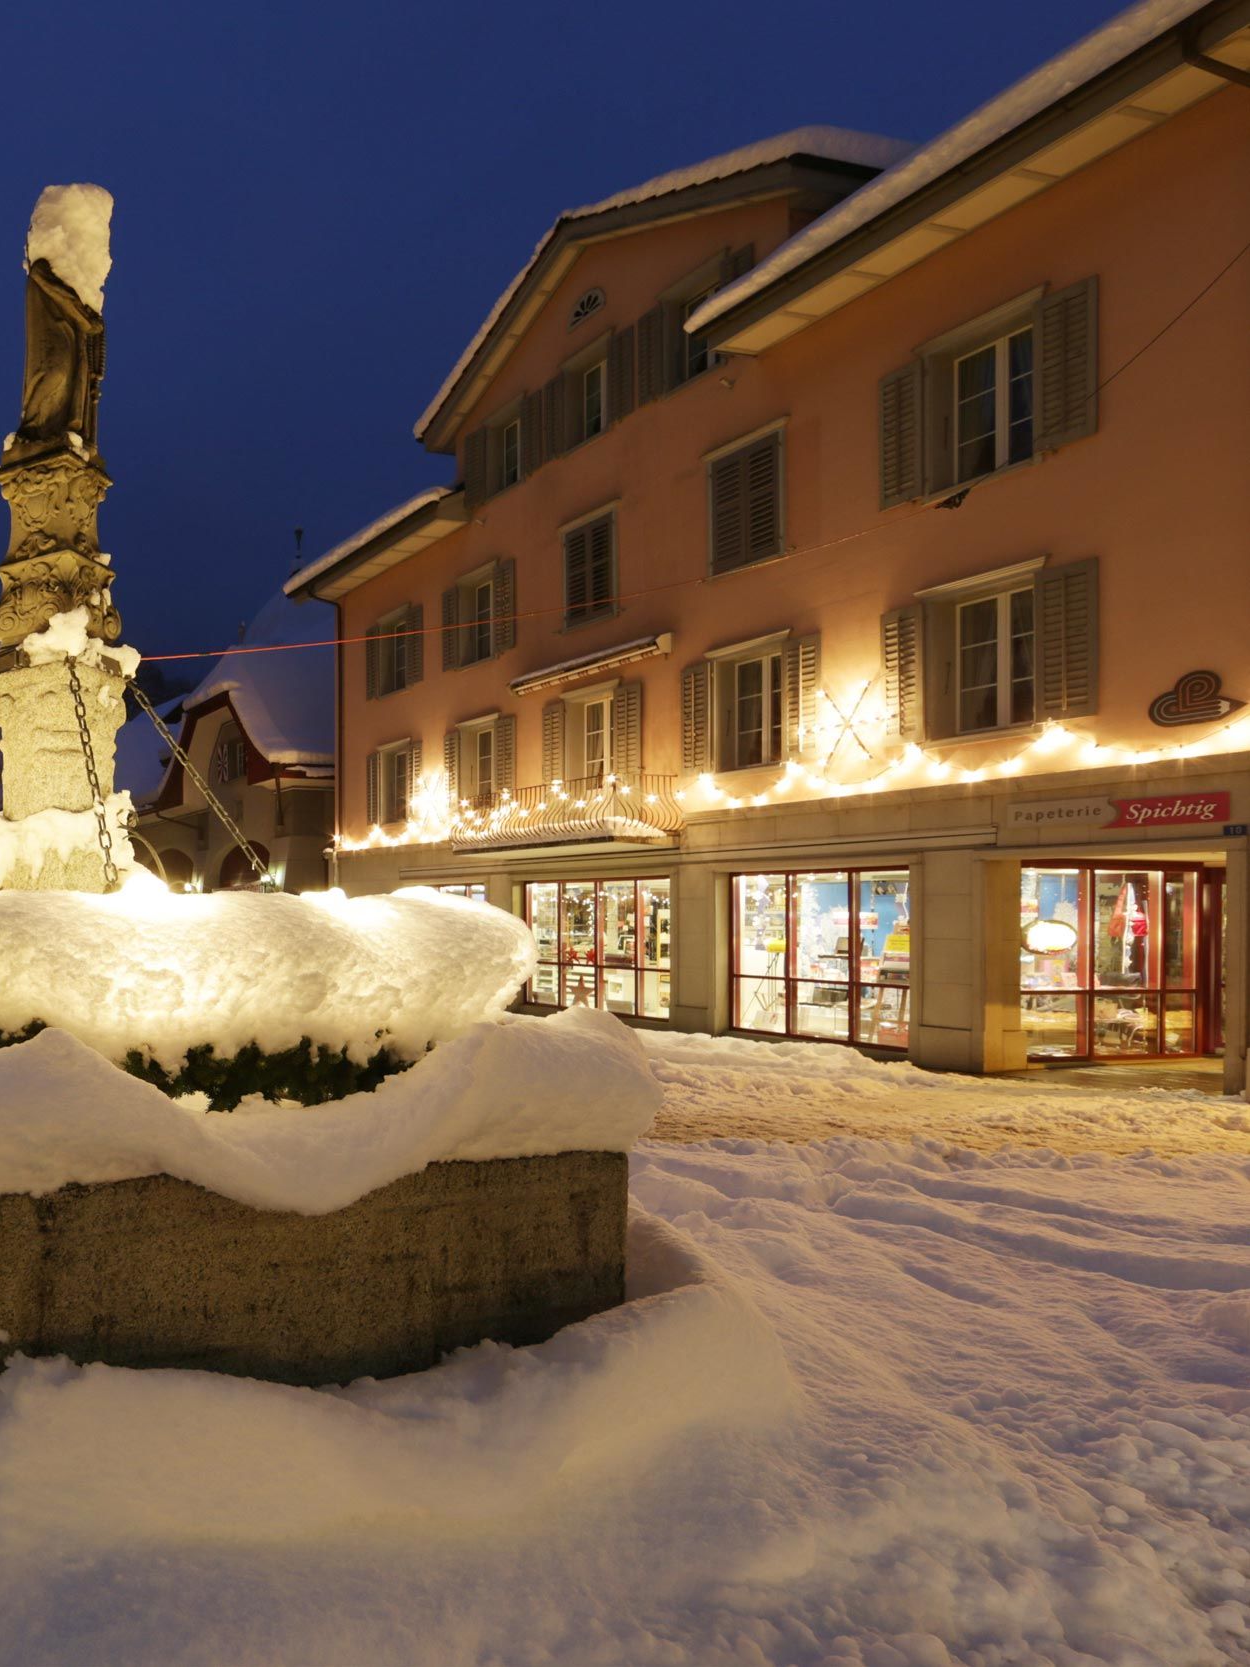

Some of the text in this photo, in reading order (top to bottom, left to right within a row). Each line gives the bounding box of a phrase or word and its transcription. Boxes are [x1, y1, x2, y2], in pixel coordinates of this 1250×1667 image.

[1014, 800, 1217, 824] Papeterie Spichtig
[1230, 826, 1243, 835] 10
